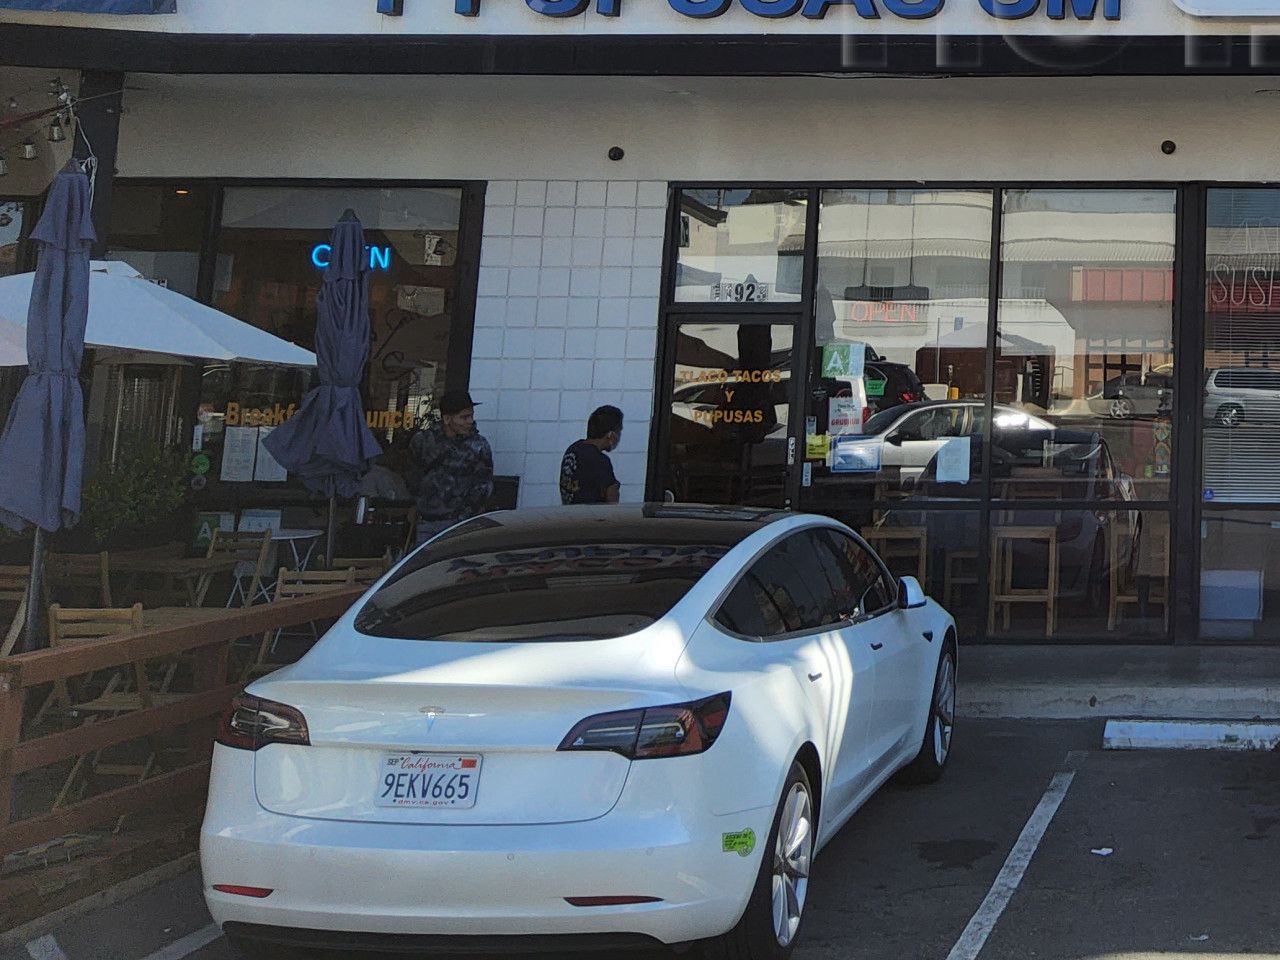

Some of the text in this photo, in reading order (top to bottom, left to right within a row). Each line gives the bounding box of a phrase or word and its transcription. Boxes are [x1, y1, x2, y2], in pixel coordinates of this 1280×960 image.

[850, 301, 917, 324] OPEN
[825, 351, 844, 371] A
[733, 370, 781, 383] TACOS
[725, 390, 735, 403] Y
[366, 405, 415, 429] unch
[693, 410, 763, 423] PUPUSAS
[401, 756, 461, 772] California
[381, 773, 470, 800] 9EKV665
